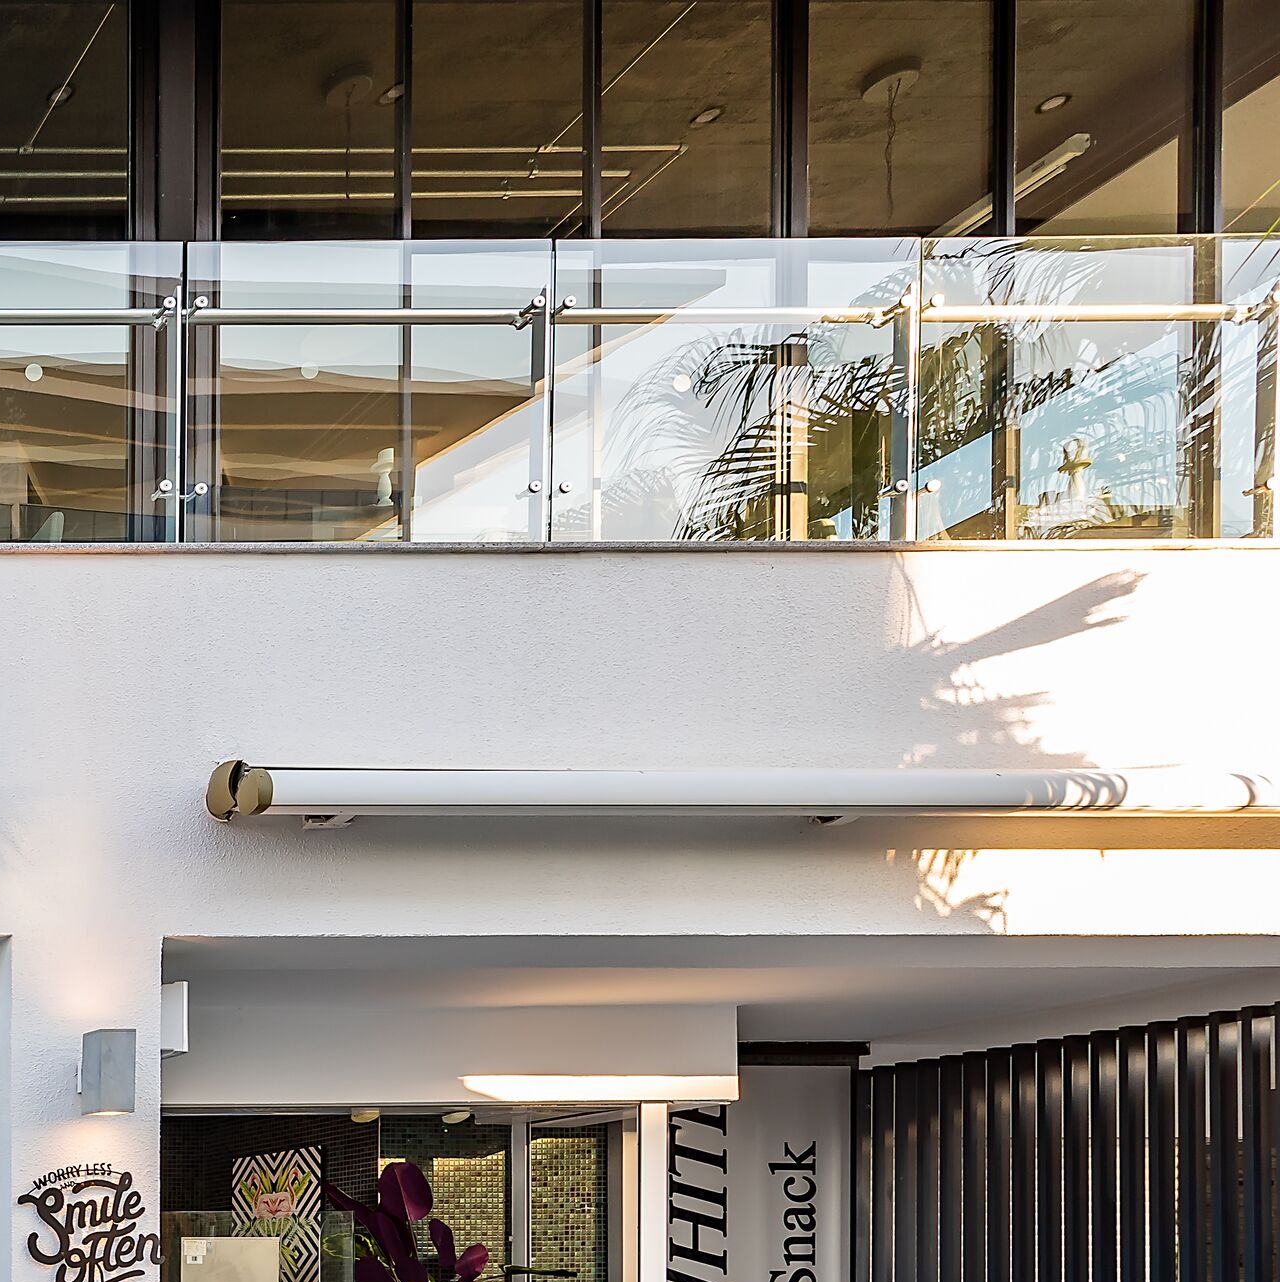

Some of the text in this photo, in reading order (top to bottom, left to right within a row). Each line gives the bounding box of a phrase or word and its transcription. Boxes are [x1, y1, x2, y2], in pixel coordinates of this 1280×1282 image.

[33, 1163, 112, 1190] WORRY LESS
[17, 1172, 146, 1265] Smile
